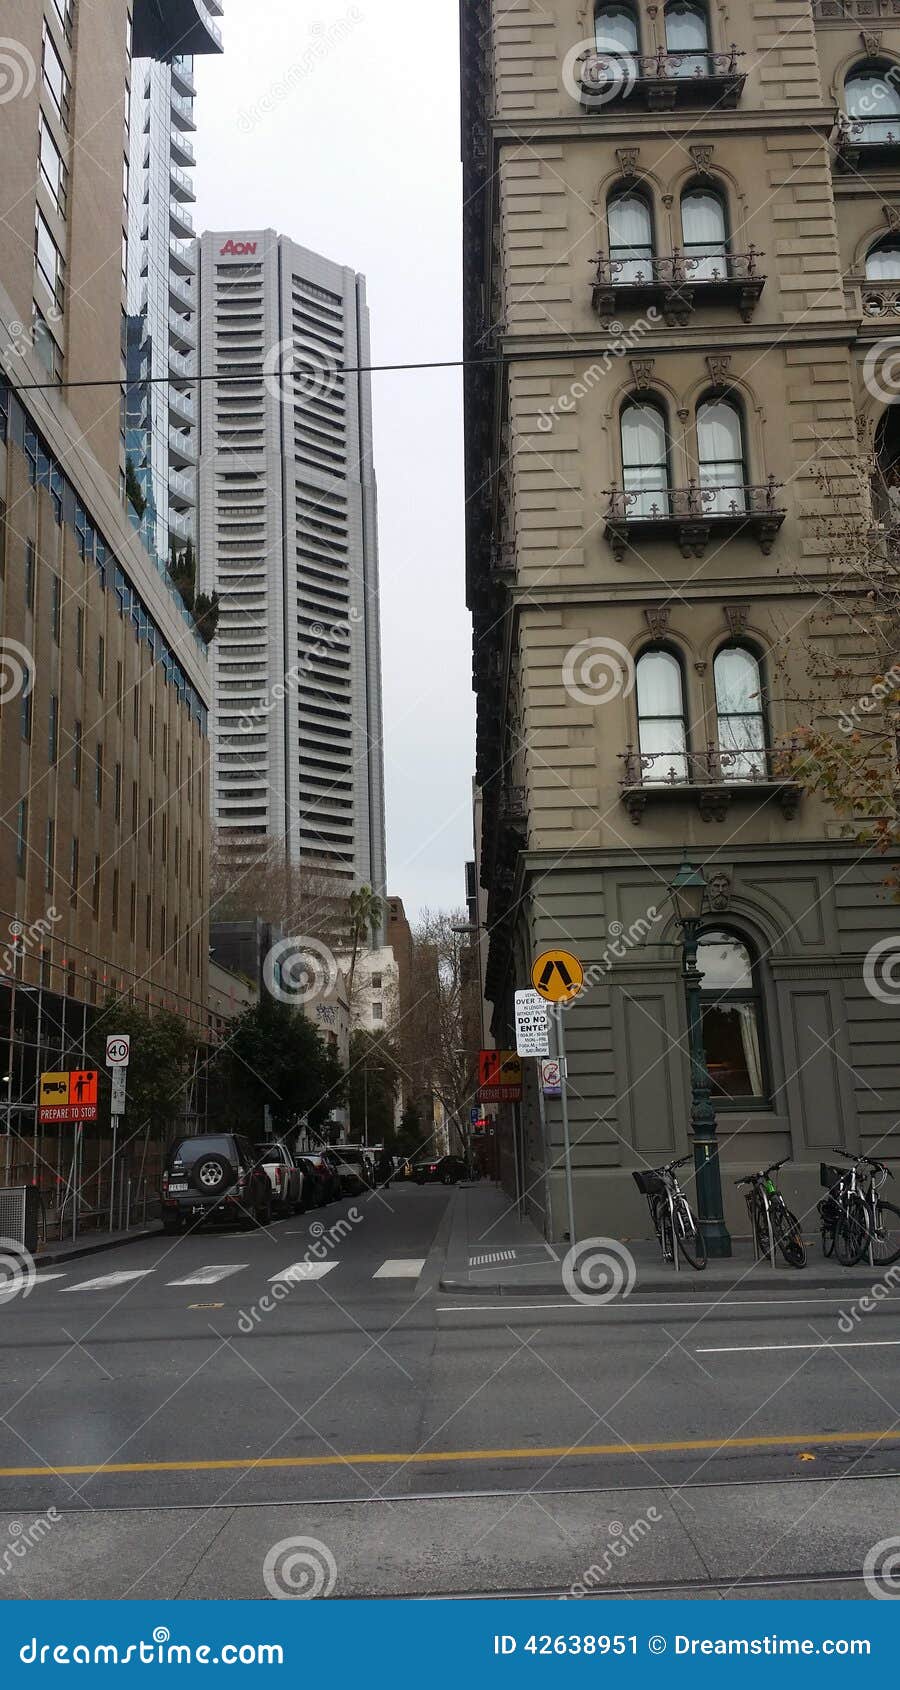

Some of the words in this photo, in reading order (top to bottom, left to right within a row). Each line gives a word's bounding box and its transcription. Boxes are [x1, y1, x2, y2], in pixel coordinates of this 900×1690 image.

[109, 1044, 127, 1057] 40
[40, 1108, 68, 1120] PREPARE
[71, 1107, 79, 1118] TO
[81, 1106, 96, 1118] STOP
